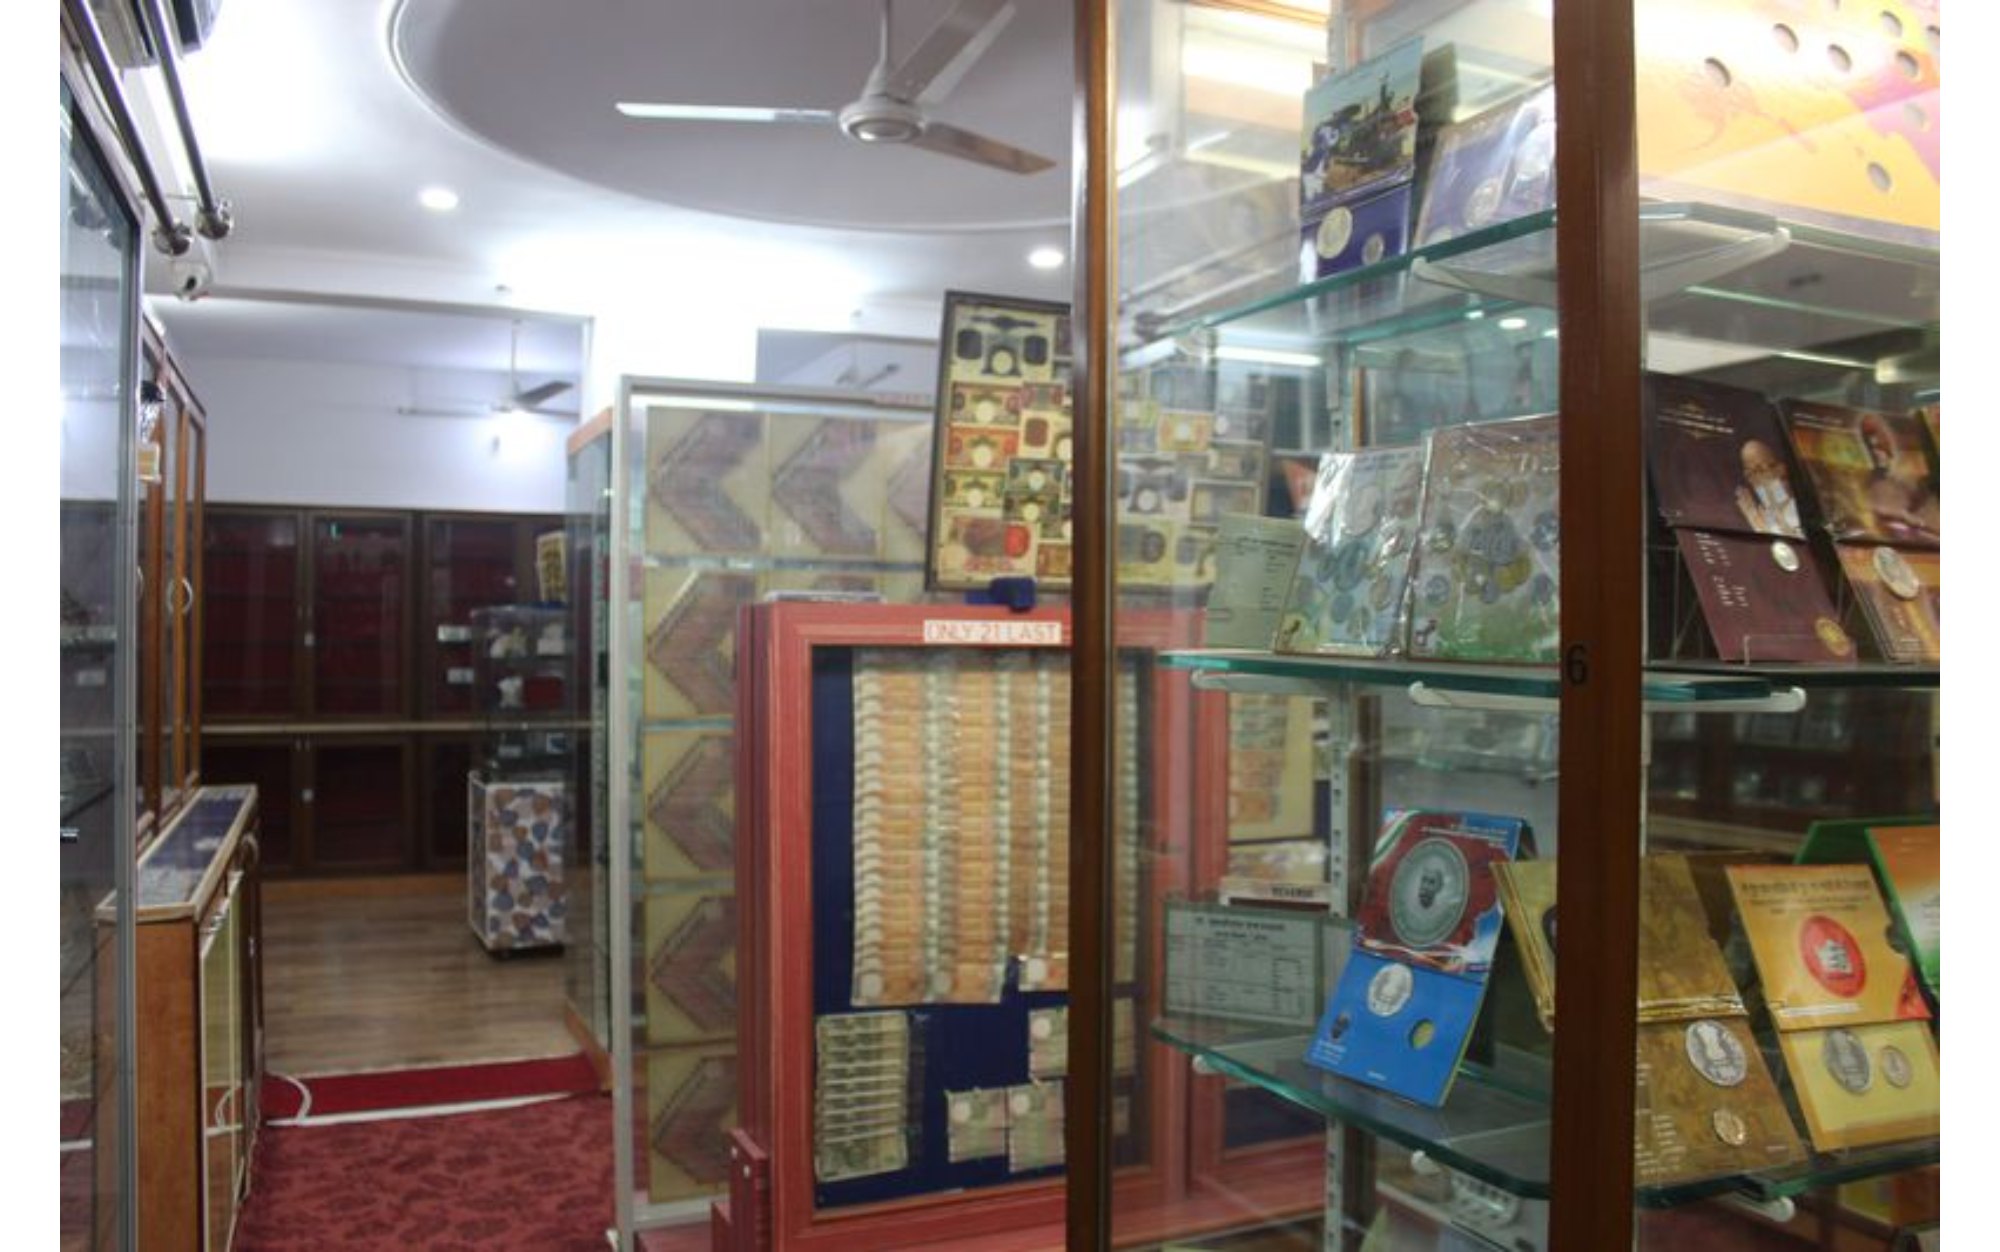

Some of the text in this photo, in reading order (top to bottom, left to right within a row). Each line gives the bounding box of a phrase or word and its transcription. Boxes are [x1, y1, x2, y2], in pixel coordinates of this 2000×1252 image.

[926, 622, 973, 640] ONLY
[1006, 624, 1057, 641] LAST
[1567, 644, 1588, 686] 6
